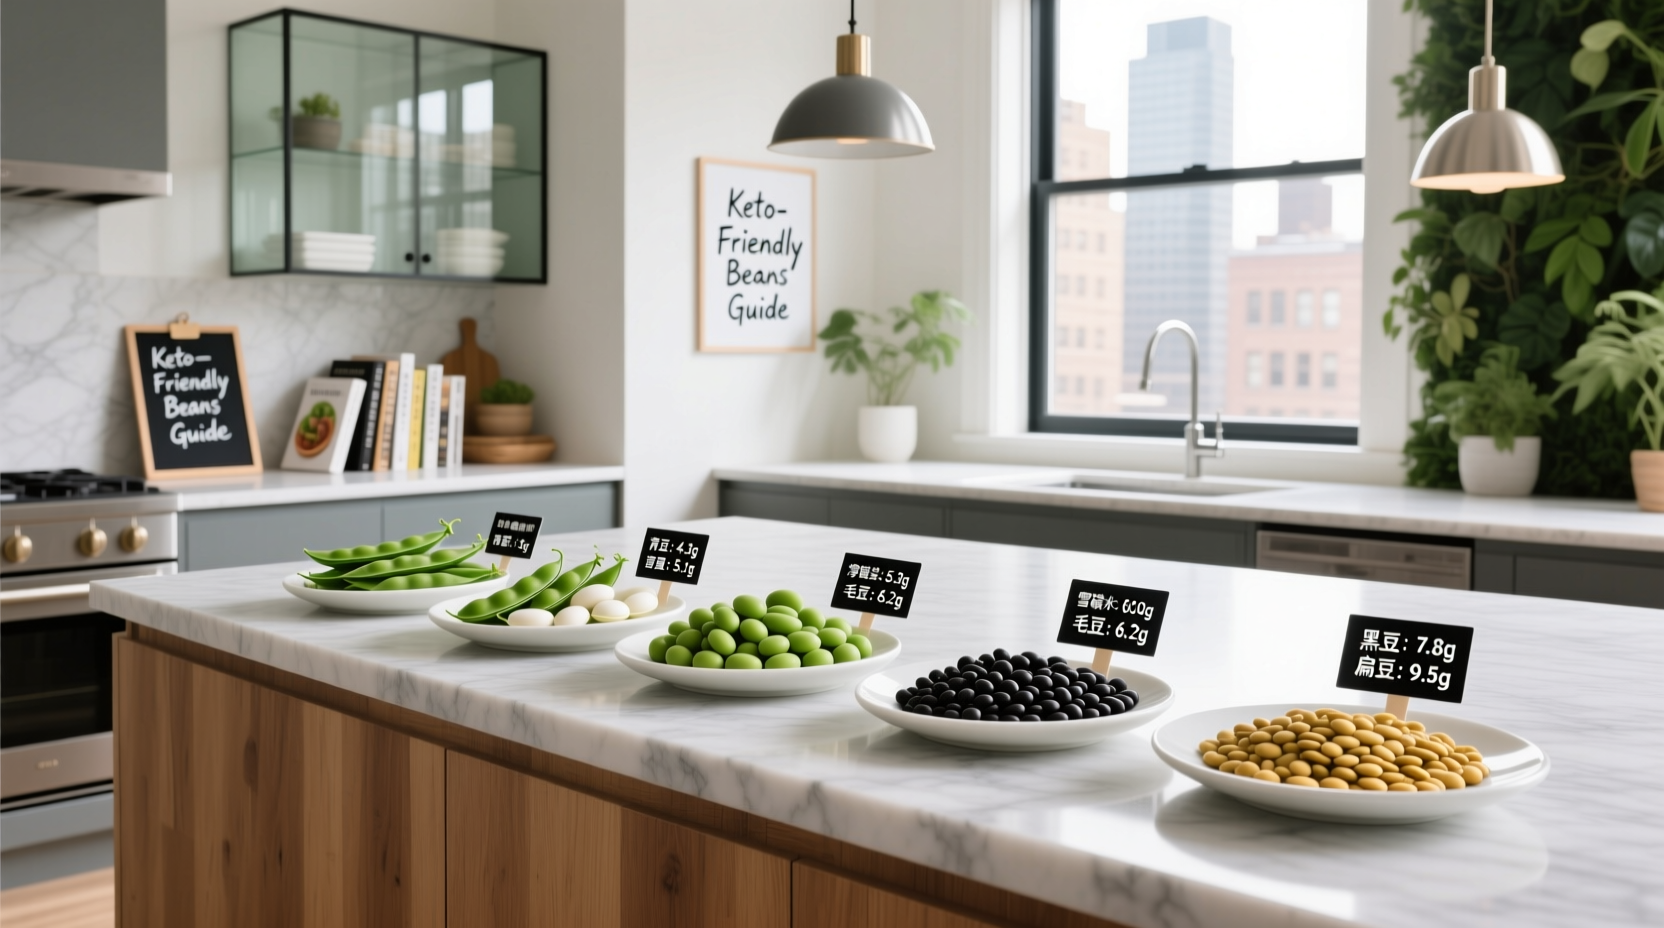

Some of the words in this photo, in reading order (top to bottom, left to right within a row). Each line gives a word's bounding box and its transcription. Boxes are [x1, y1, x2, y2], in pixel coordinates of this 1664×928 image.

[728, 187, 787, 219] Keto-
[718, 225, 803, 270] Friendly
[727, 259, 788, 286] Beans
[728, 293, 789, 326] Guide
[153, 367, 229, 400] Friendly
[163, 394, 221, 419] Beans
[169, 417, 232, 450] Guide
[1115, 621, 1149, 646] 6.2g
[1417, 636, 1456, 663] 7.8g
[1409, 663, 1451, 691] 9.5g
